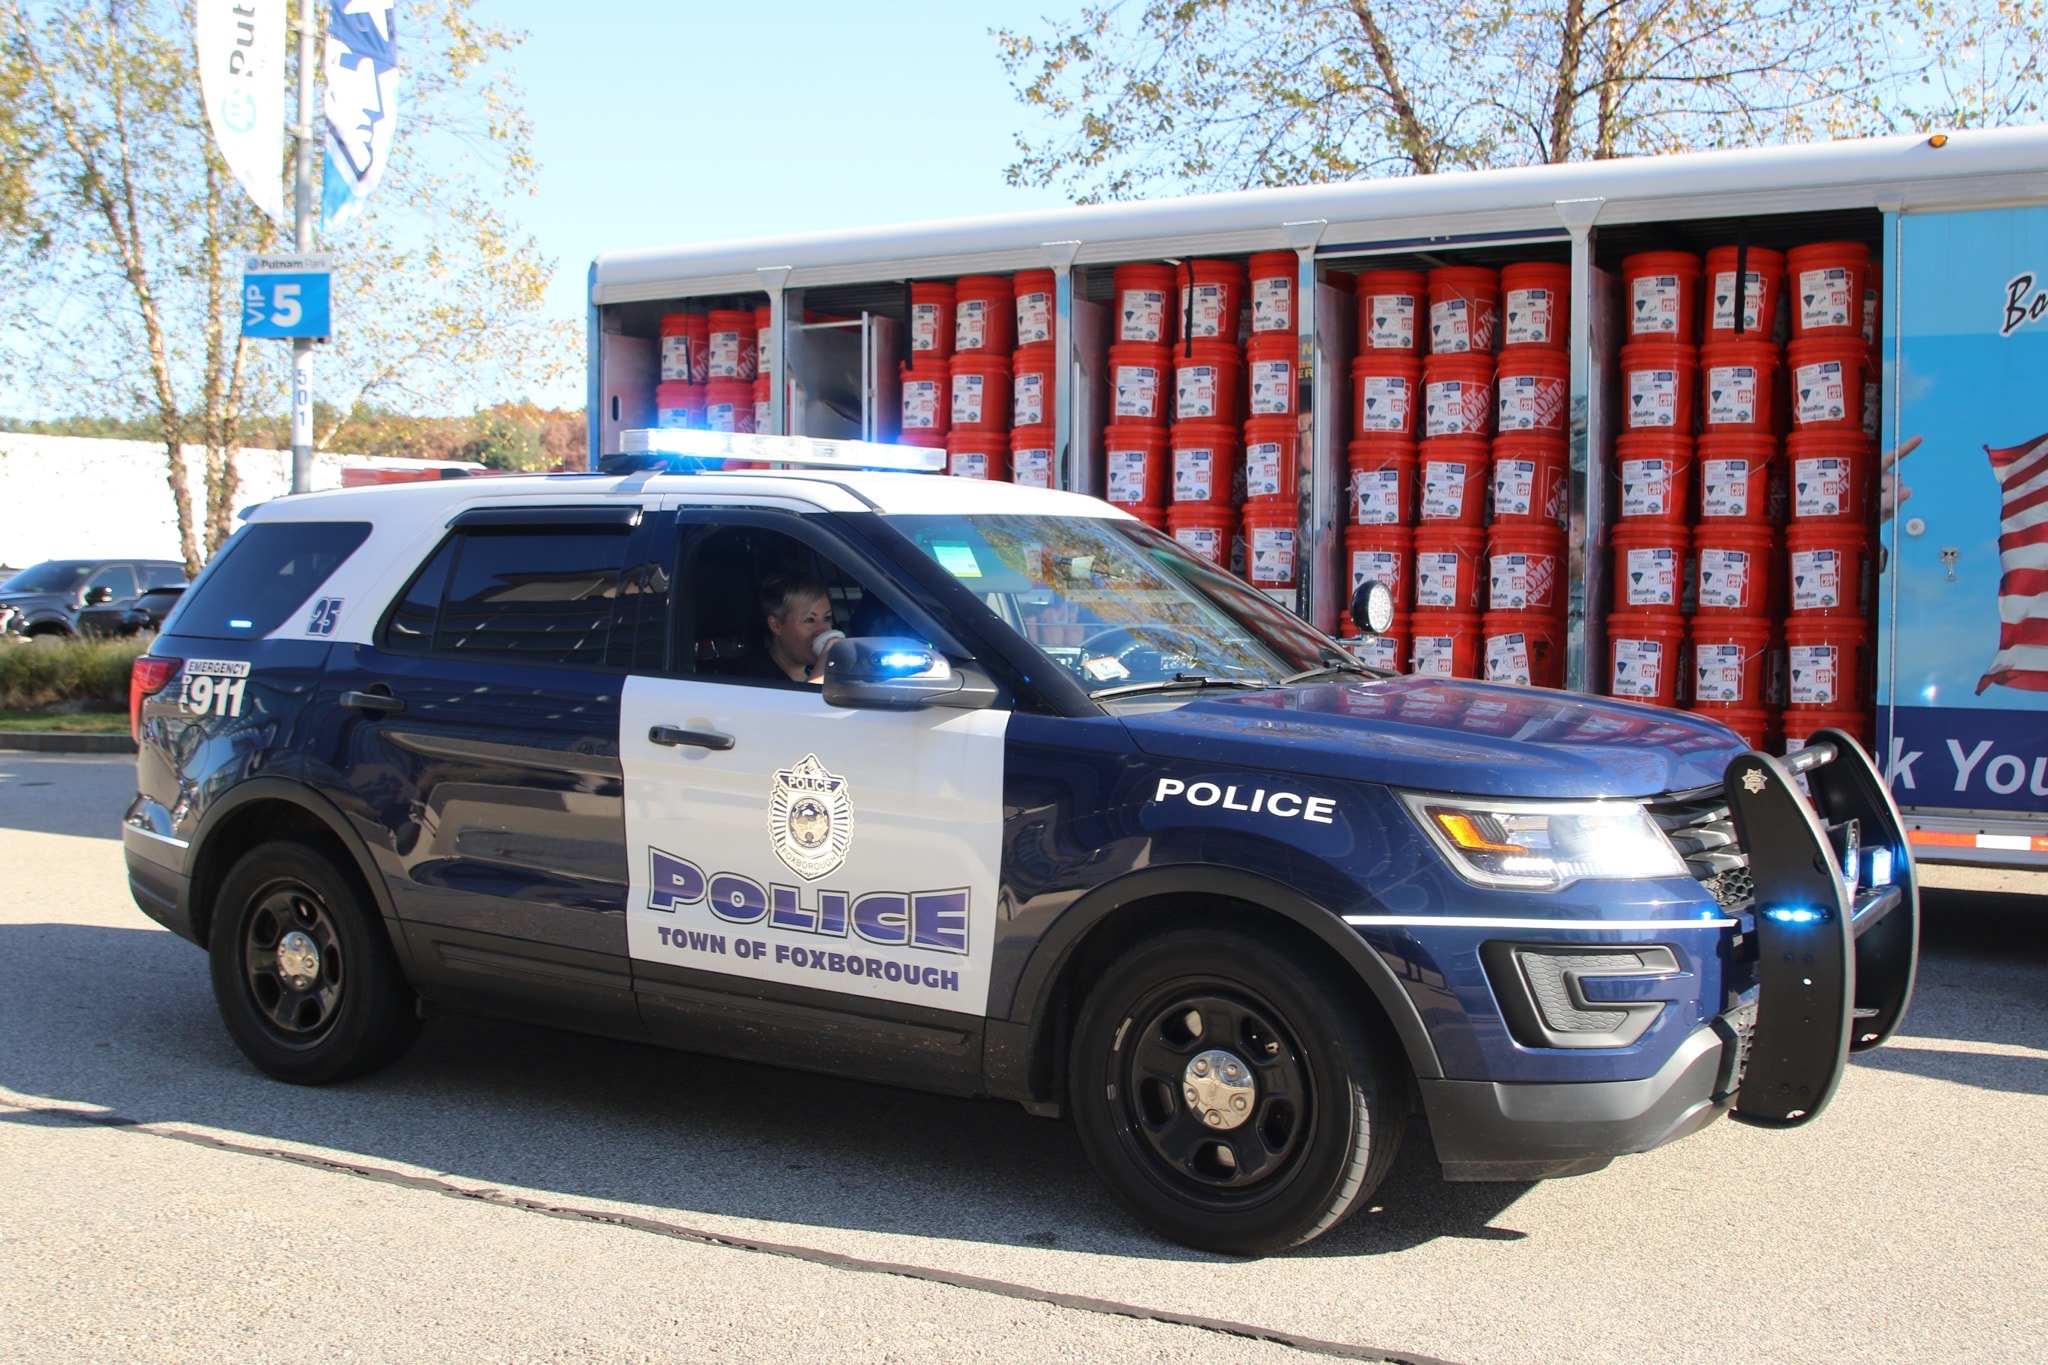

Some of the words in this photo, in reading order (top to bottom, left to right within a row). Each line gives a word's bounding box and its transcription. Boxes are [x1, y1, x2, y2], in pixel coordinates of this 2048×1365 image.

[261, 260, 303, 269] Putnam
[246, 284, 265, 326] VIP
[271, 284, 302, 327] 5
[306, 597, 345, 637] 25
[188, 661, 248, 674] EMERGENCY
[178, 675, 192, 713] DIAL
[189, 676, 247, 717] 911
[788, 777, 832, 792] POLICE
[1155, 778, 1336, 824] POLICE
[781, 848, 837, 870] FOXBOROUGH
[647, 845, 971, 956] POLICE
[658, 927, 726, 954] TOWN
[734, 938, 767, 959] OF
[775, 944, 959, 991] FOXBOROUGH
